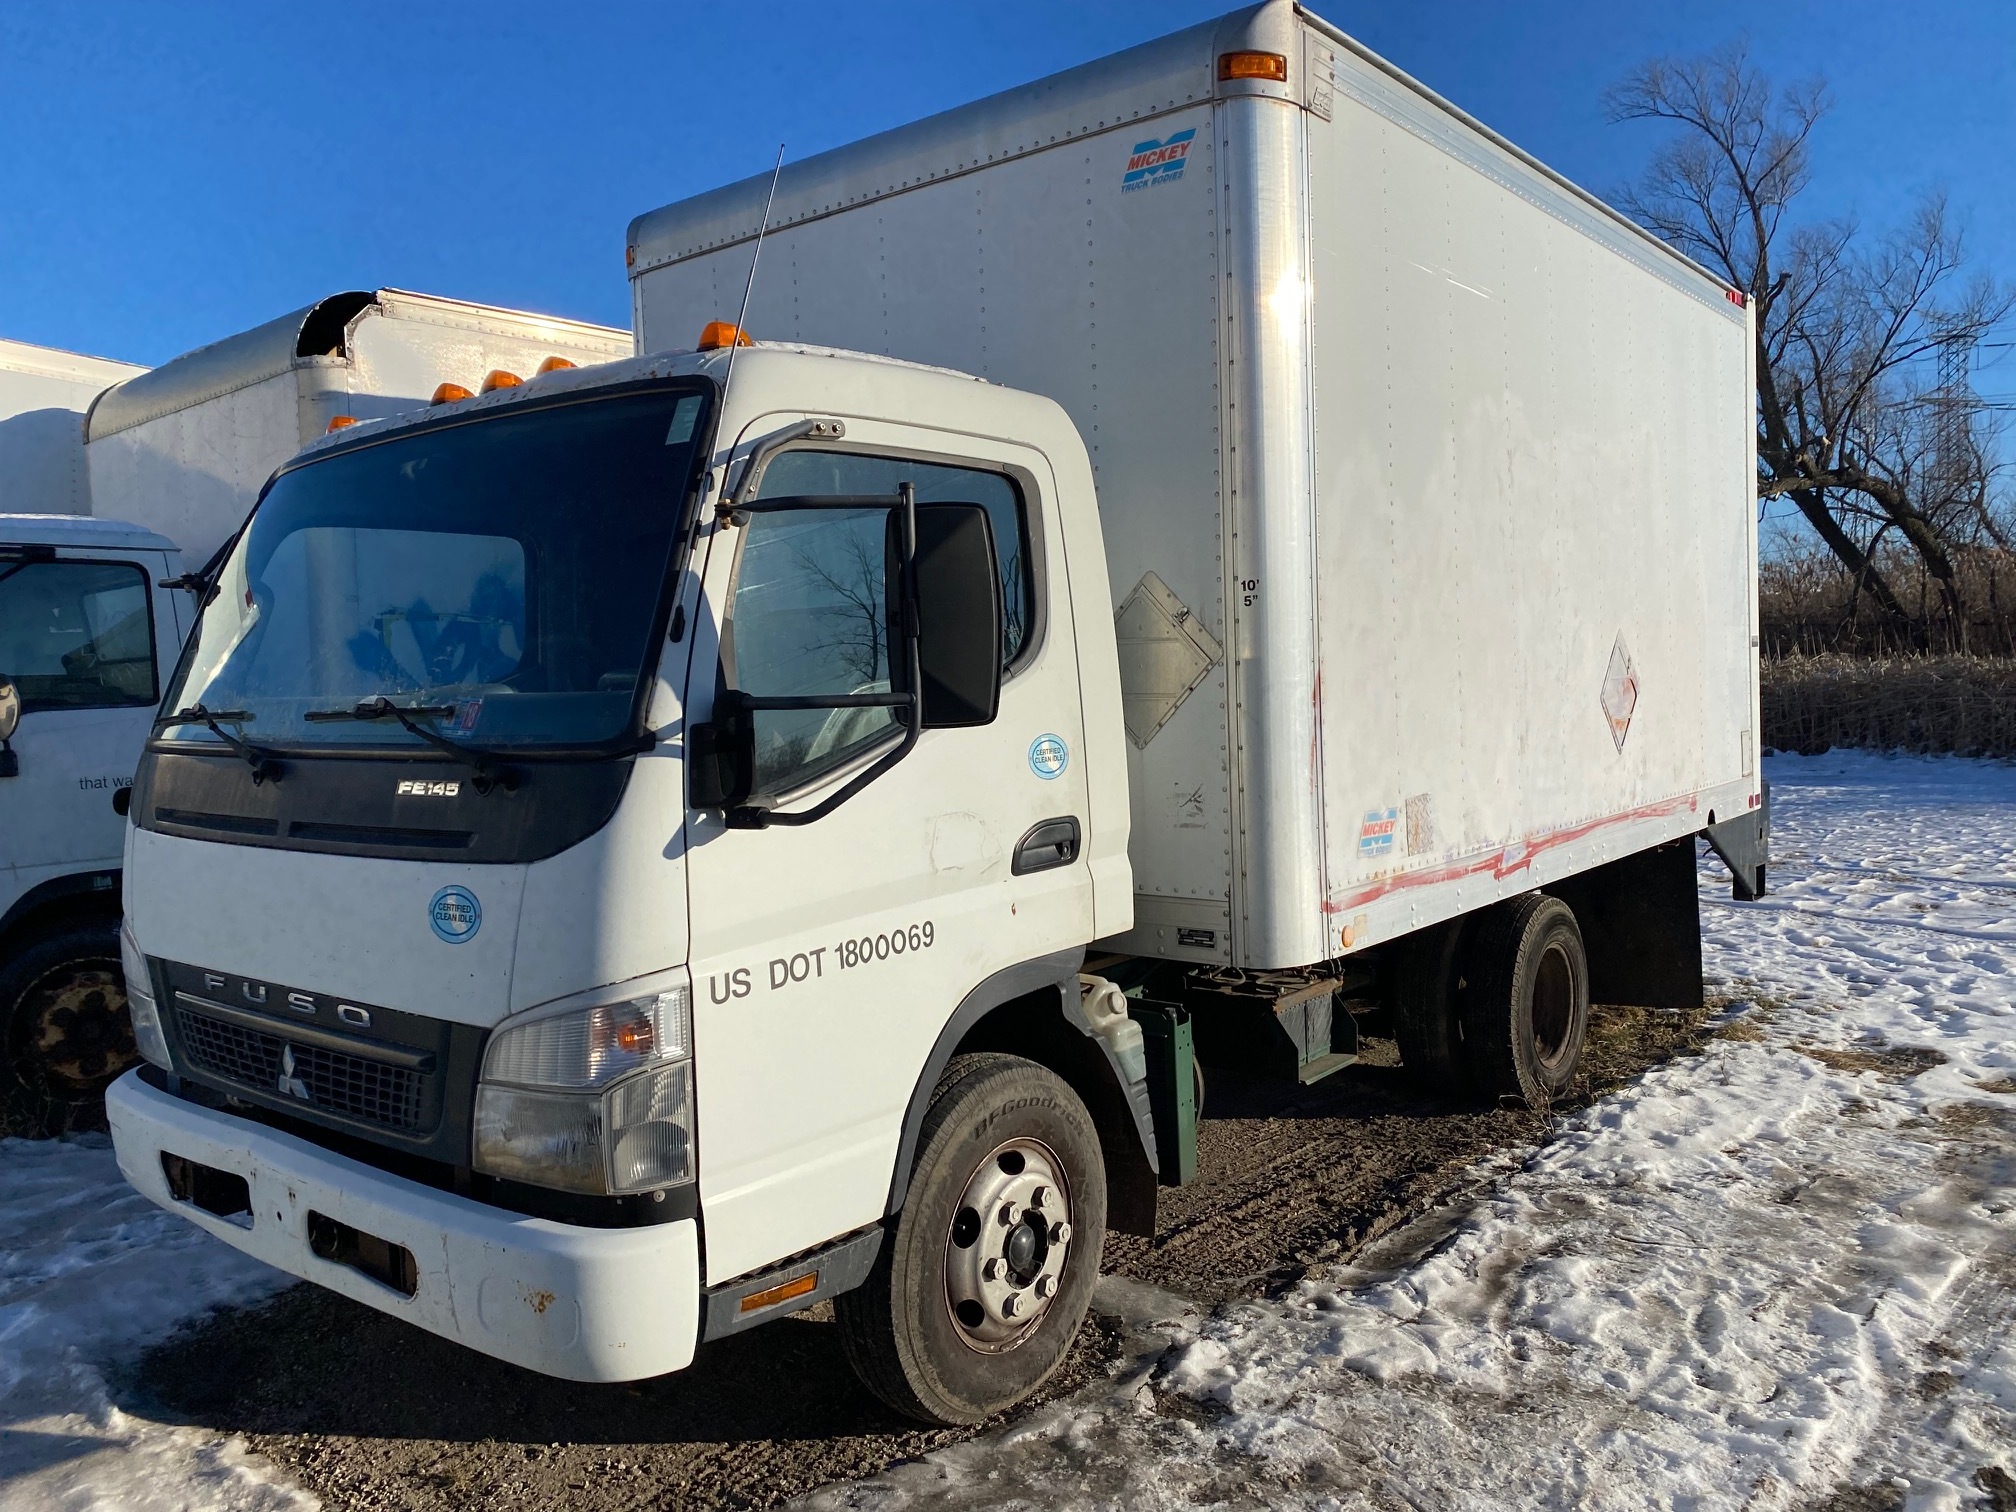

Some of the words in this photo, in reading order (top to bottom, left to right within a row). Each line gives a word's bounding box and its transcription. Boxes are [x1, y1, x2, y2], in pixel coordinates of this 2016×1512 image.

[1127, 141, 1191, 171] MICKEY
[1121, 179, 1150, 193] TRUCK
[1151, 170, 1184, 186] BODIES
[1036, 747, 1061, 756] CERTIFIED
[1053, 754, 1063, 762] IDLE
[79, 776, 108, 789] that
[112, 776, 134, 787] wa
[398, 781, 460, 796] FE145
[1362, 820, 1396, 836] MICKEY
[438, 902, 472, 913] CERTIFIED
[436, 912, 457, 922] CLEAN
[458, 915, 474, 923] IDLE
[710, 968, 751, 1005] US
[769, 947, 827, 990] DOT
[834, 921, 935, 969] 1800069
[204, 973, 371, 1027] FUSO
